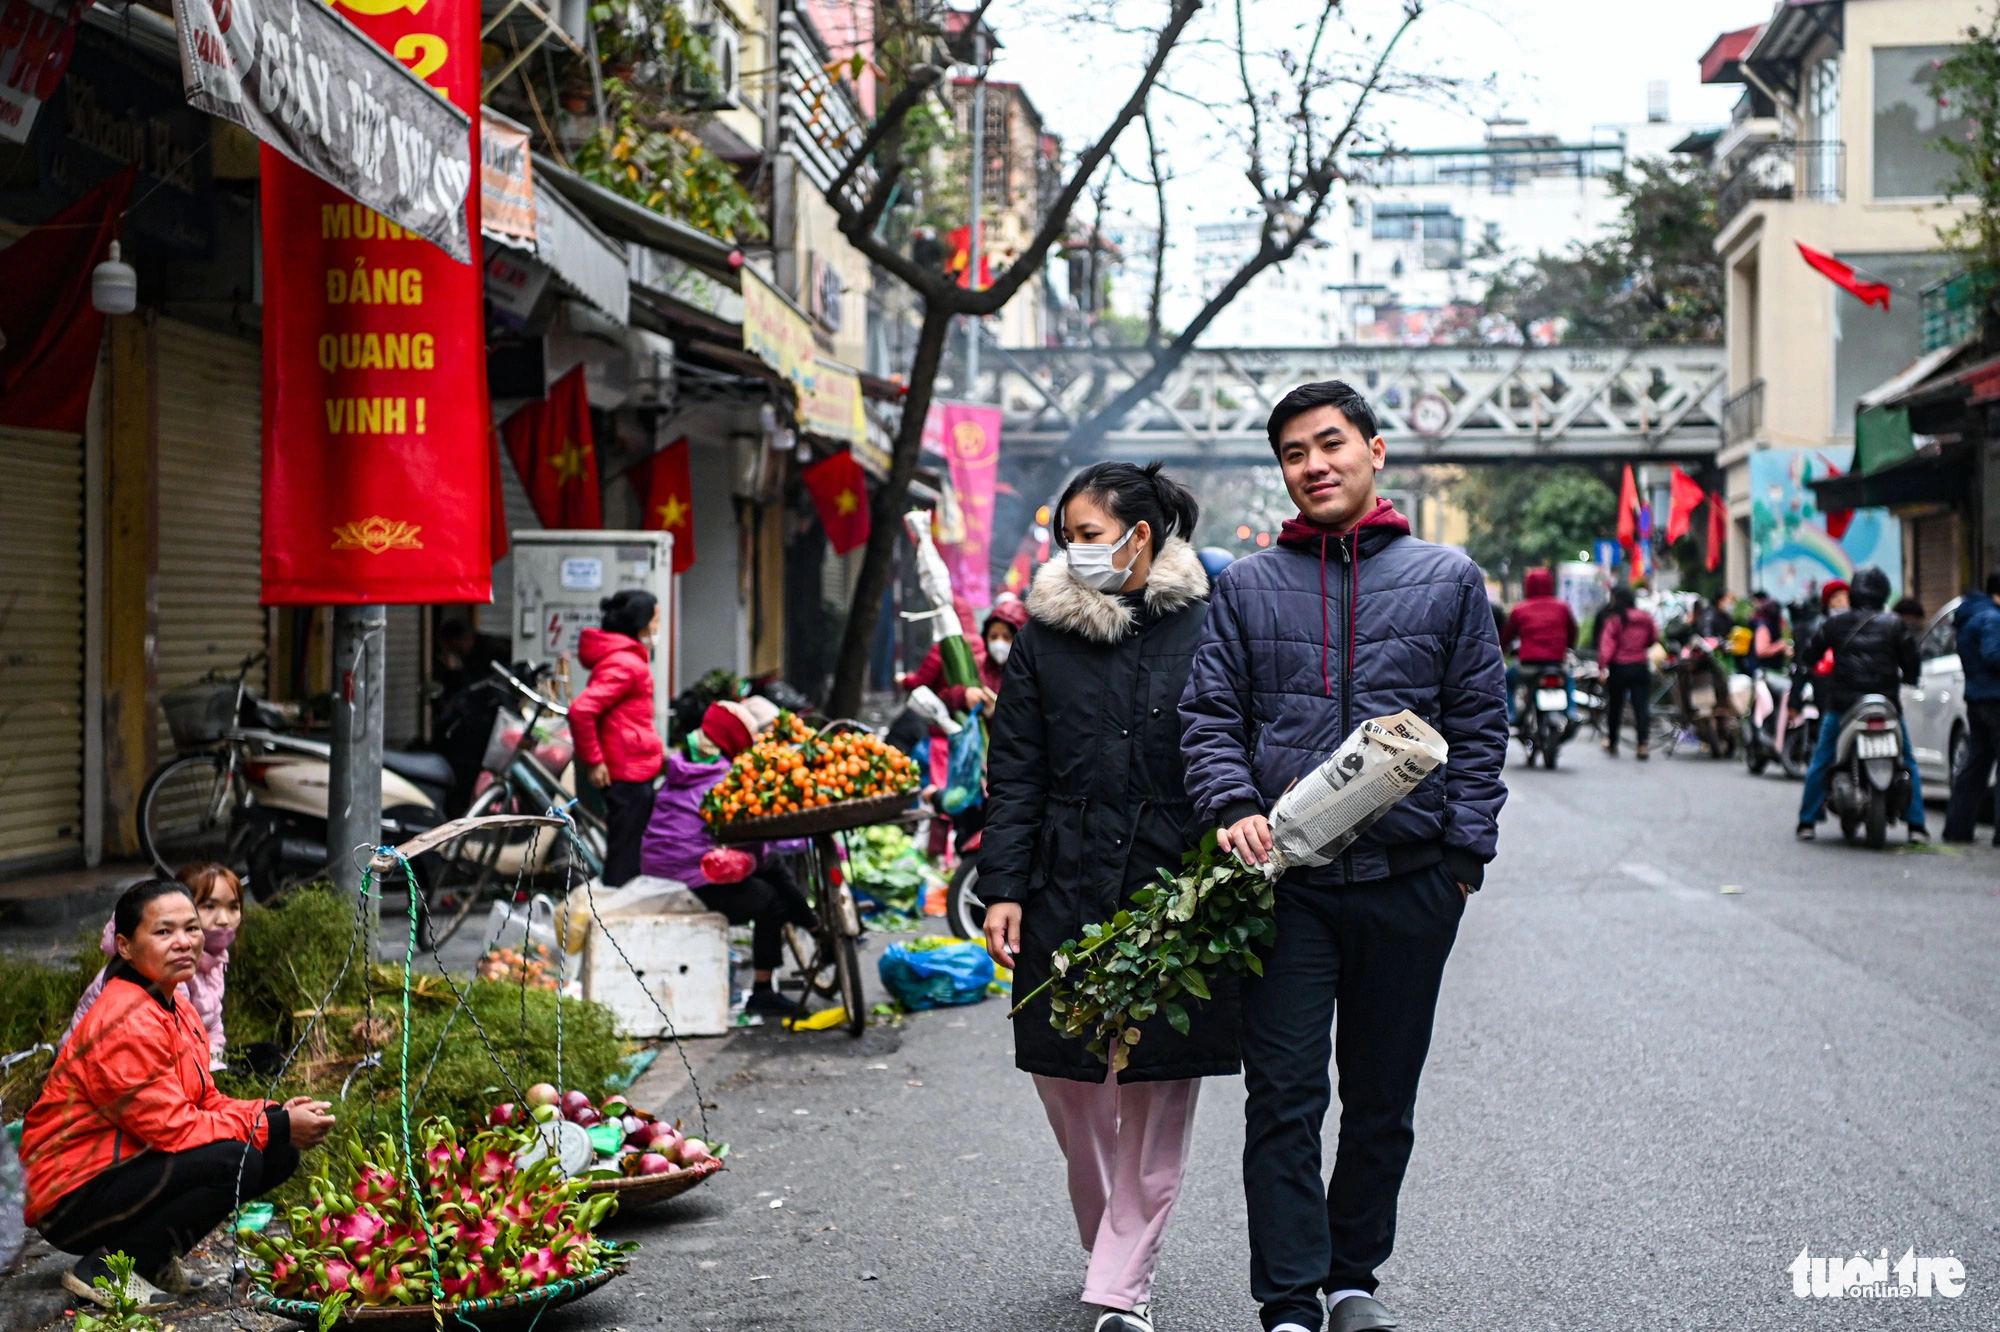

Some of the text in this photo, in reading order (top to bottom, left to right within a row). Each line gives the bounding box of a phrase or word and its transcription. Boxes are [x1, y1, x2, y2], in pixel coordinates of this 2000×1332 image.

[321, 203, 423, 241] MUN
[327, 256, 423, 305] ĐẢNG
[318, 332, 435, 374] QUANG
[325, 397, 407, 434] VINH
